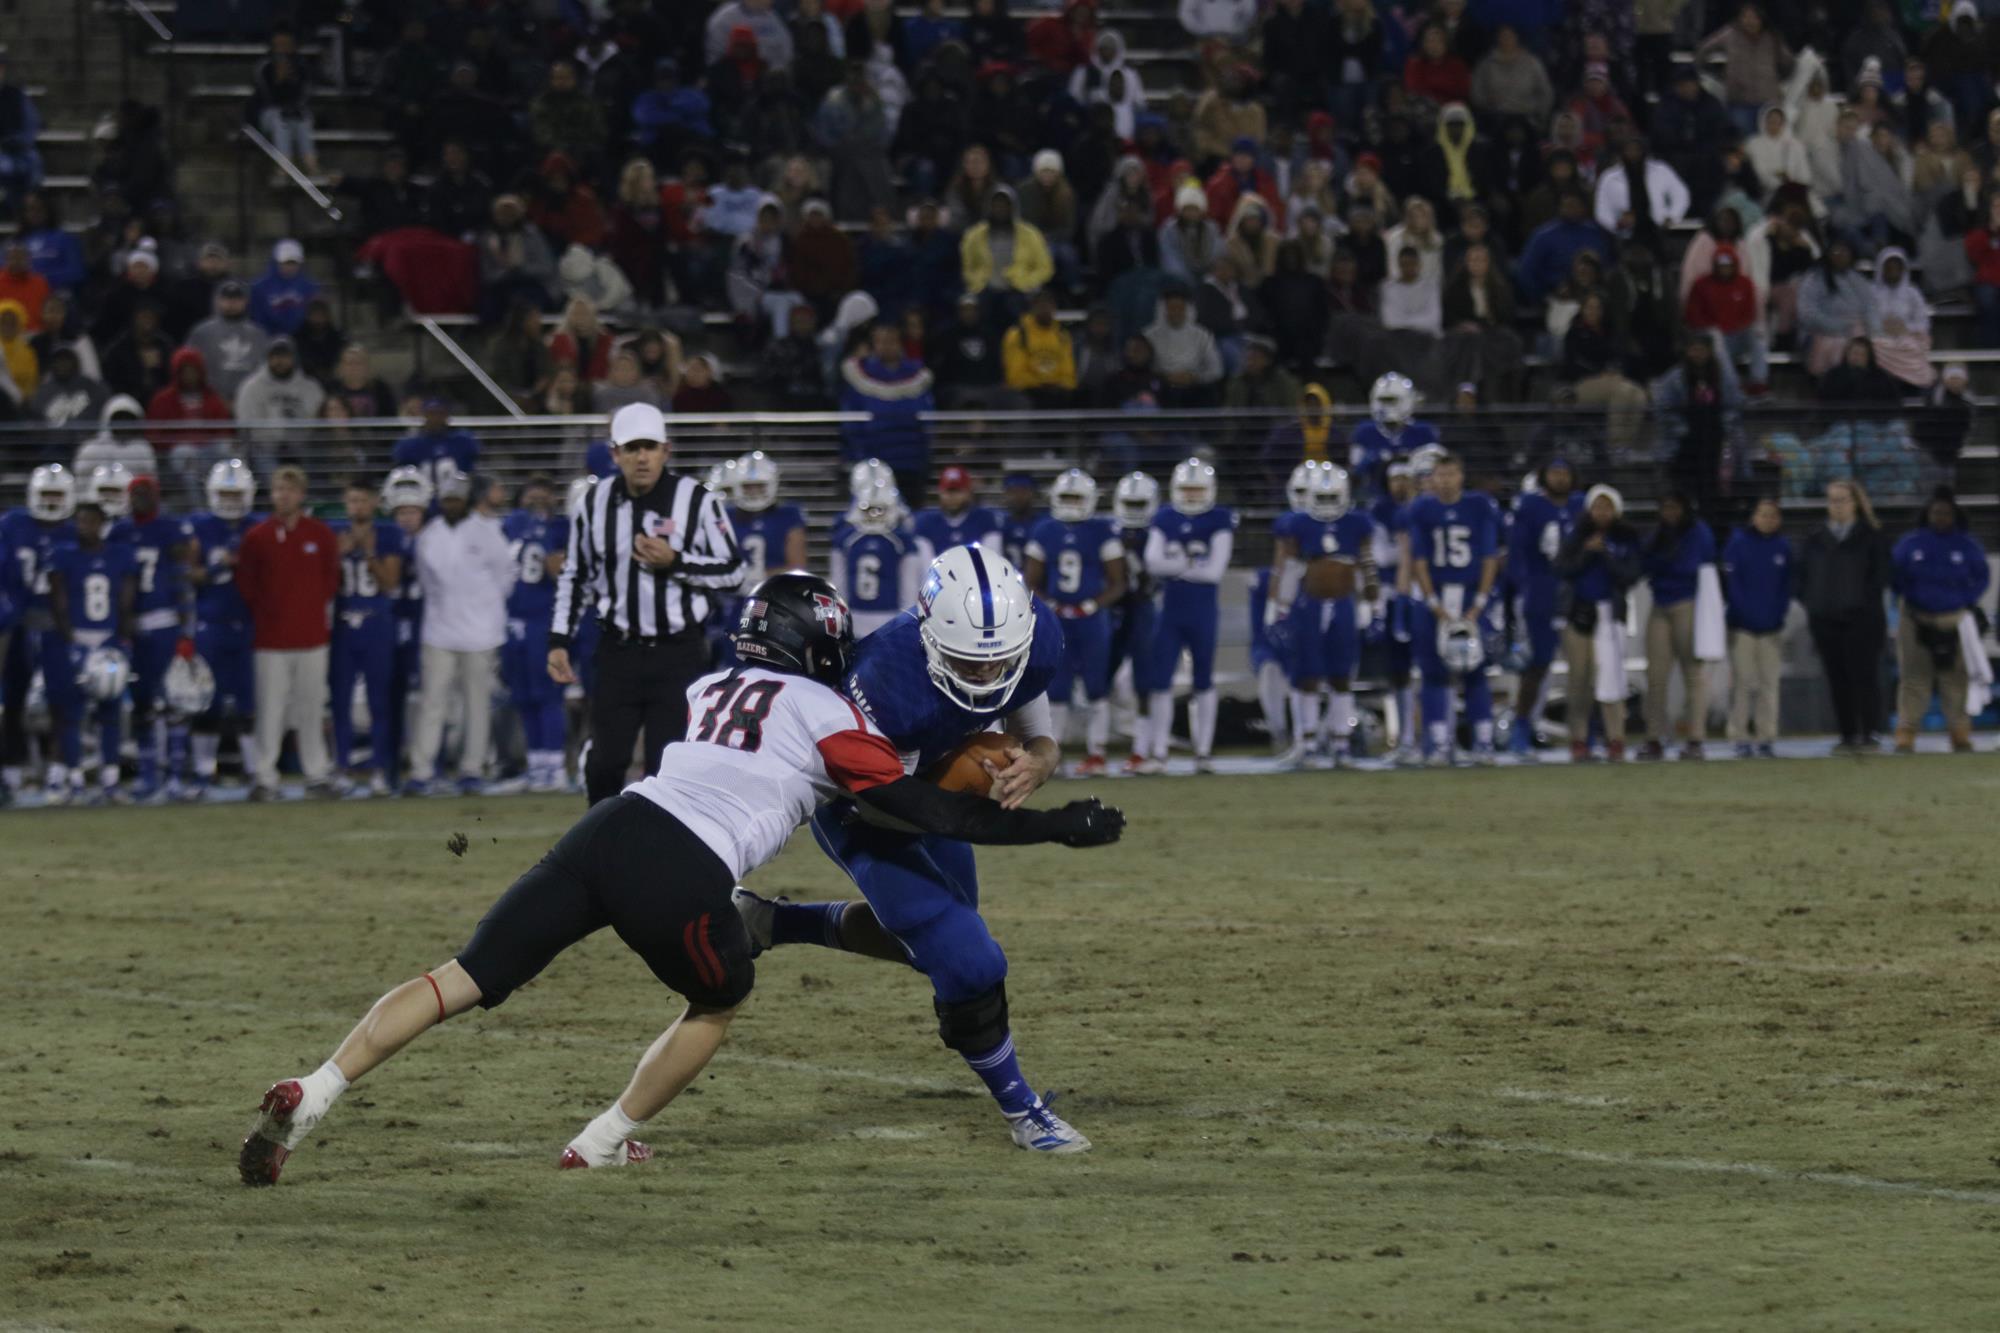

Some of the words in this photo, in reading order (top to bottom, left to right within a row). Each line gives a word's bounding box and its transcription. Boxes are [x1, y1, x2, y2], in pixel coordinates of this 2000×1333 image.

[1432, 525, 1472, 568] 15
[856, 554, 881, 601] 6
[1058, 549, 1082, 594] 9
[84, 574, 111, 622] 8
[757, 620, 768, 632] 38
[695, 677, 786, 753] 38
